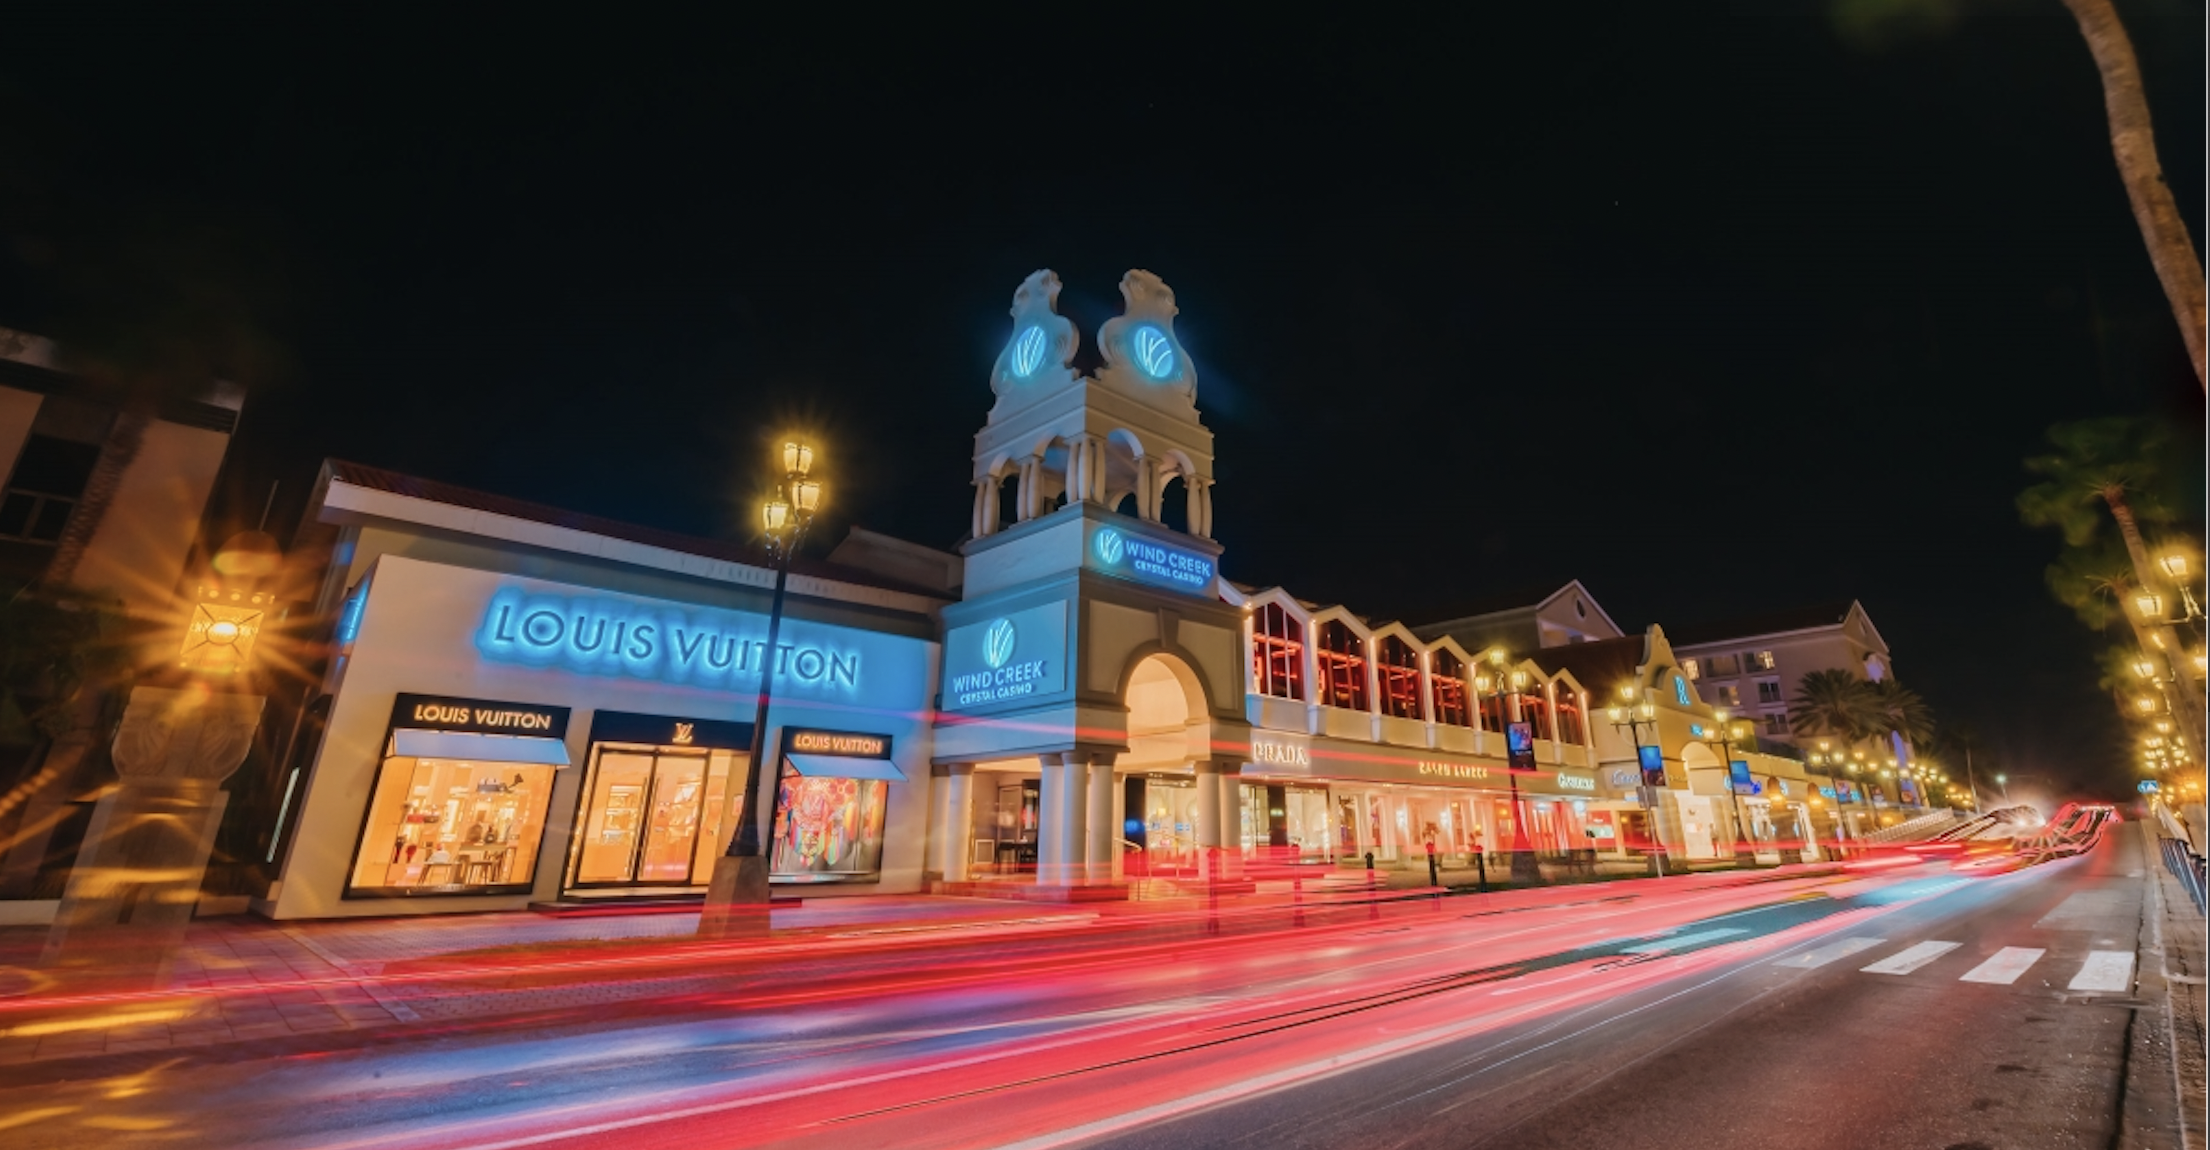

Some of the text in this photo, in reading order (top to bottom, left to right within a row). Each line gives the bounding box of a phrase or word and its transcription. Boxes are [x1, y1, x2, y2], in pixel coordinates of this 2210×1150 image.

[1126, 540, 1211, 577] WIND CREEK
[1135, 560, 1204, 586] CRYSTAL CASINO
[495, 605, 857, 686] LOUIS VUITTON
[953, 660, 1043, 693] WIND CREEK
[960, 682, 1032, 704] CRYSTAL CASINO
[414, 704, 552, 729] LOUIS VUITTON
[795, 734, 883, 754] LOUIS VUITTON
[1253, 742, 1308, 765] PRADA
